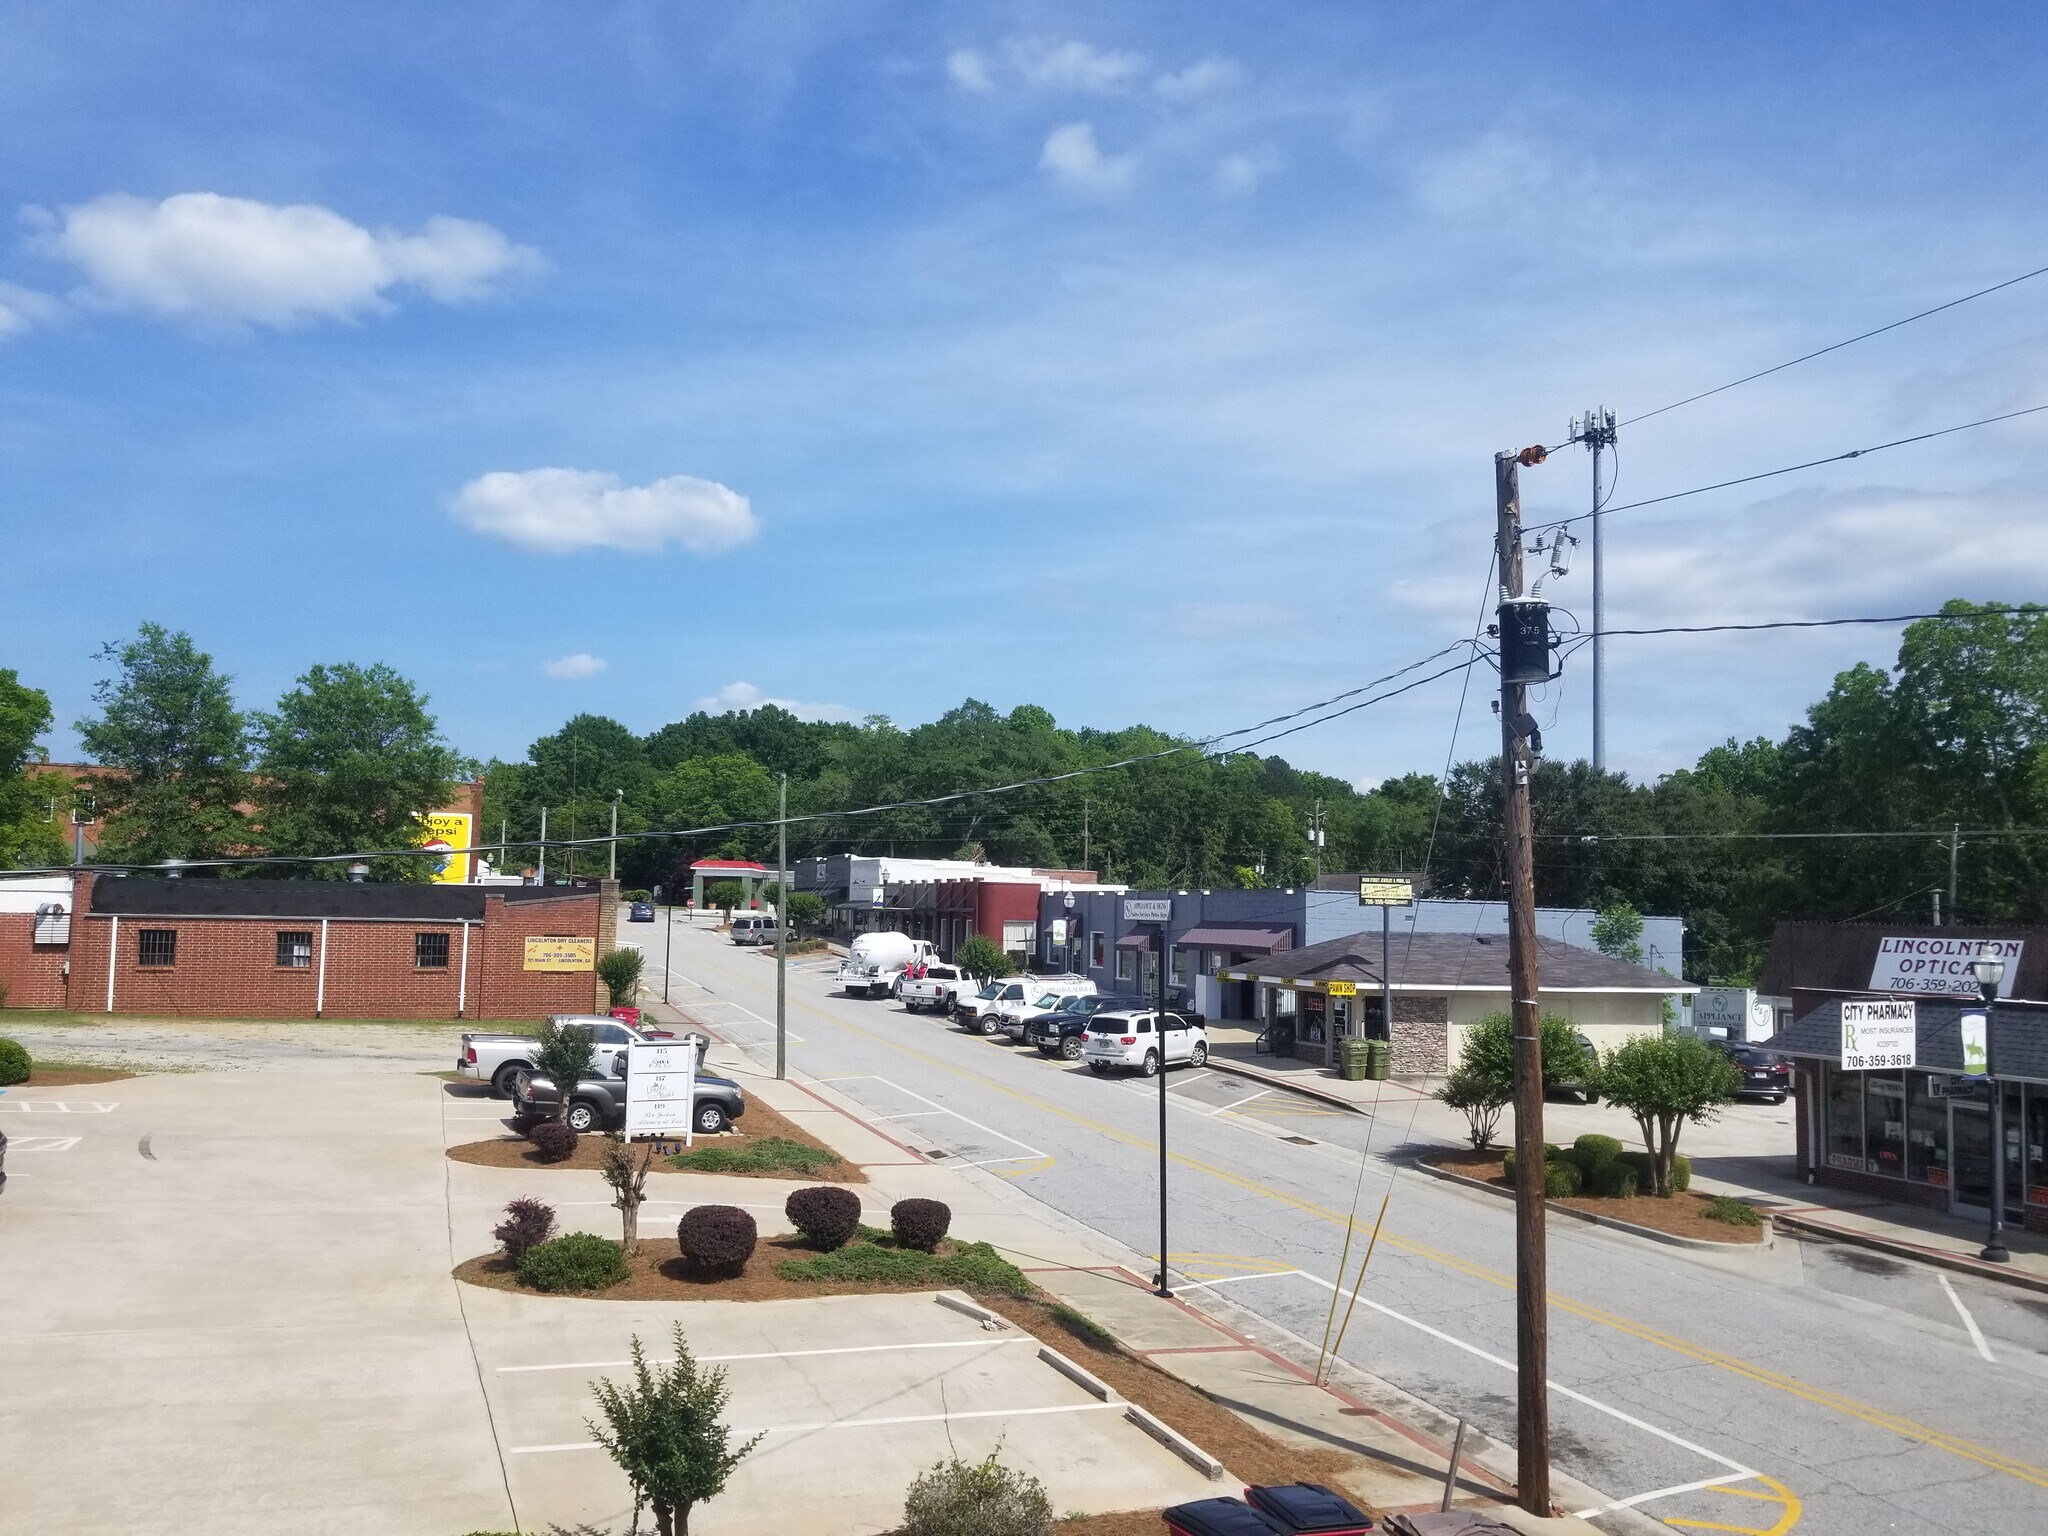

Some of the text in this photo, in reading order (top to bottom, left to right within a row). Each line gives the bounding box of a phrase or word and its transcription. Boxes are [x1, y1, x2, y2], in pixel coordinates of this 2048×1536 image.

[428, 828, 456, 836] epsi
[1900, 959, 1975, 975] OPTICA
[1330, 983, 1356, 993] PAWN SHOP
[1700, 1013, 1743, 1021] APPLIANCE
[1844, 1004, 1913, 1020] CITY PHARMACY
[1847, 1054, 1911, 1067] 706-359-3618
[1880, 1151, 1897, 1161] OPEN
